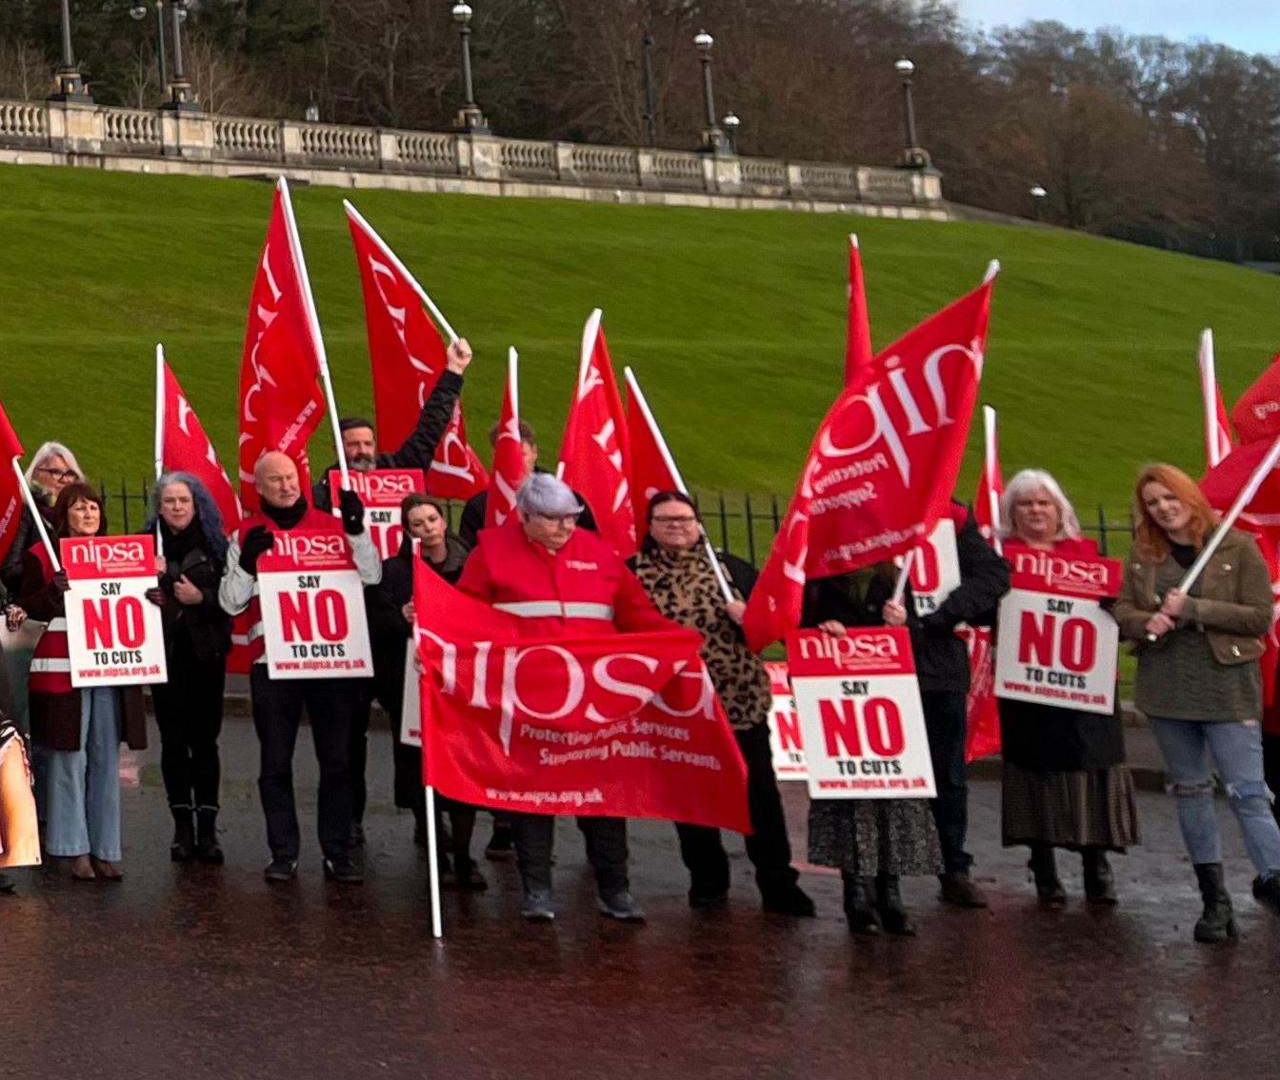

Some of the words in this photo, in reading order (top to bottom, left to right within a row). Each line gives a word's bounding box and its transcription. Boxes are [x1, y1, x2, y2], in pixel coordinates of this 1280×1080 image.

[370, 511, 392, 523] SAY
[71, 540, 144, 572] nipsa
[911, 536, 940, 592] O
[1016, 552, 1109, 586] nipsa
[100, 582, 122, 596] SAY
[297, 575, 321, 589] SAY
[278, 589, 349, 642] NO
[1047, 598, 1074, 614] SAY
[82, 595, 146, 651] NO
[290, 644, 308, 658] TO
[311, 643, 346, 658] CUTS
[798, 632, 899, 670] nipsa
[1018, 610, 1098, 673] NO
[93, 651, 109, 665] TO
[111, 650, 143, 664] CUTS
[841, 680, 869, 696] SAY
[1026, 667, 1044, 683] TO
[1047, 671, 1087, 689] CUTS
[631, 717, 690, 742] Services
[774, 711, 804, 751] N
[818, 697, 906, 758] NO
[611, 739, 656, 759] Public
[836, 760, 856, 776] TO
[860, 759, 902, 776] CUTS
